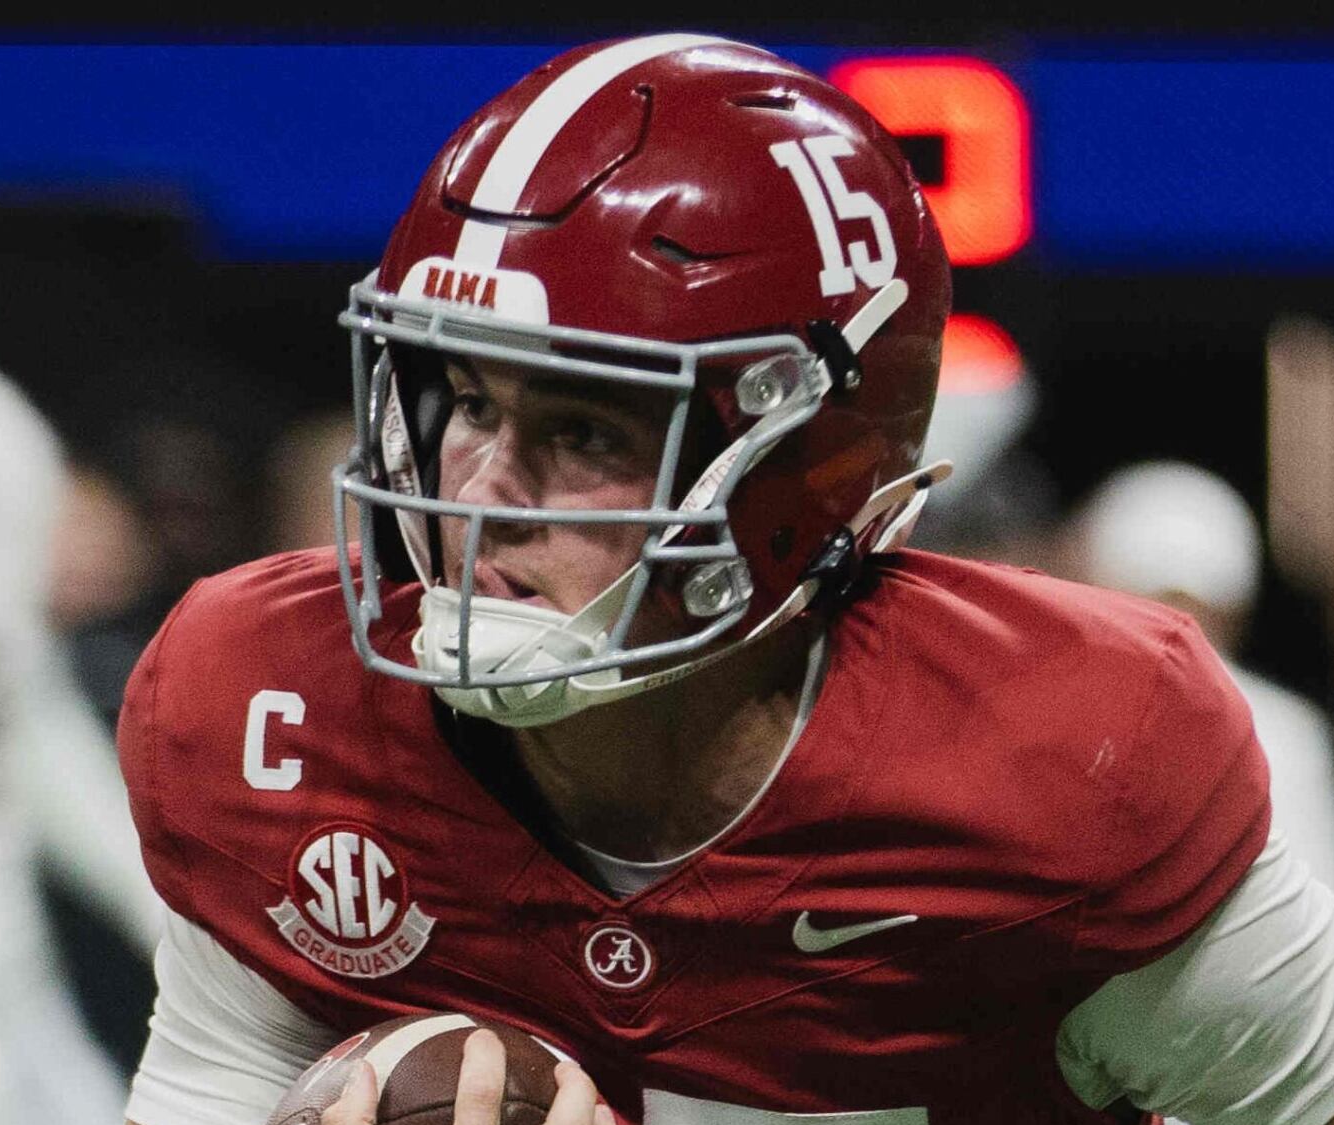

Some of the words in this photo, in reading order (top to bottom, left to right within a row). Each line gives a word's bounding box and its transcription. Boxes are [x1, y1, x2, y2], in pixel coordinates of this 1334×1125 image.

[768, 134, 898, 297] 15
[422, 265, 498, 310] BAMA
[243, 689, 306, 792] C
[298, 832, 397, 939] SEC
[293, 928, 416, 975] GRADUATE
